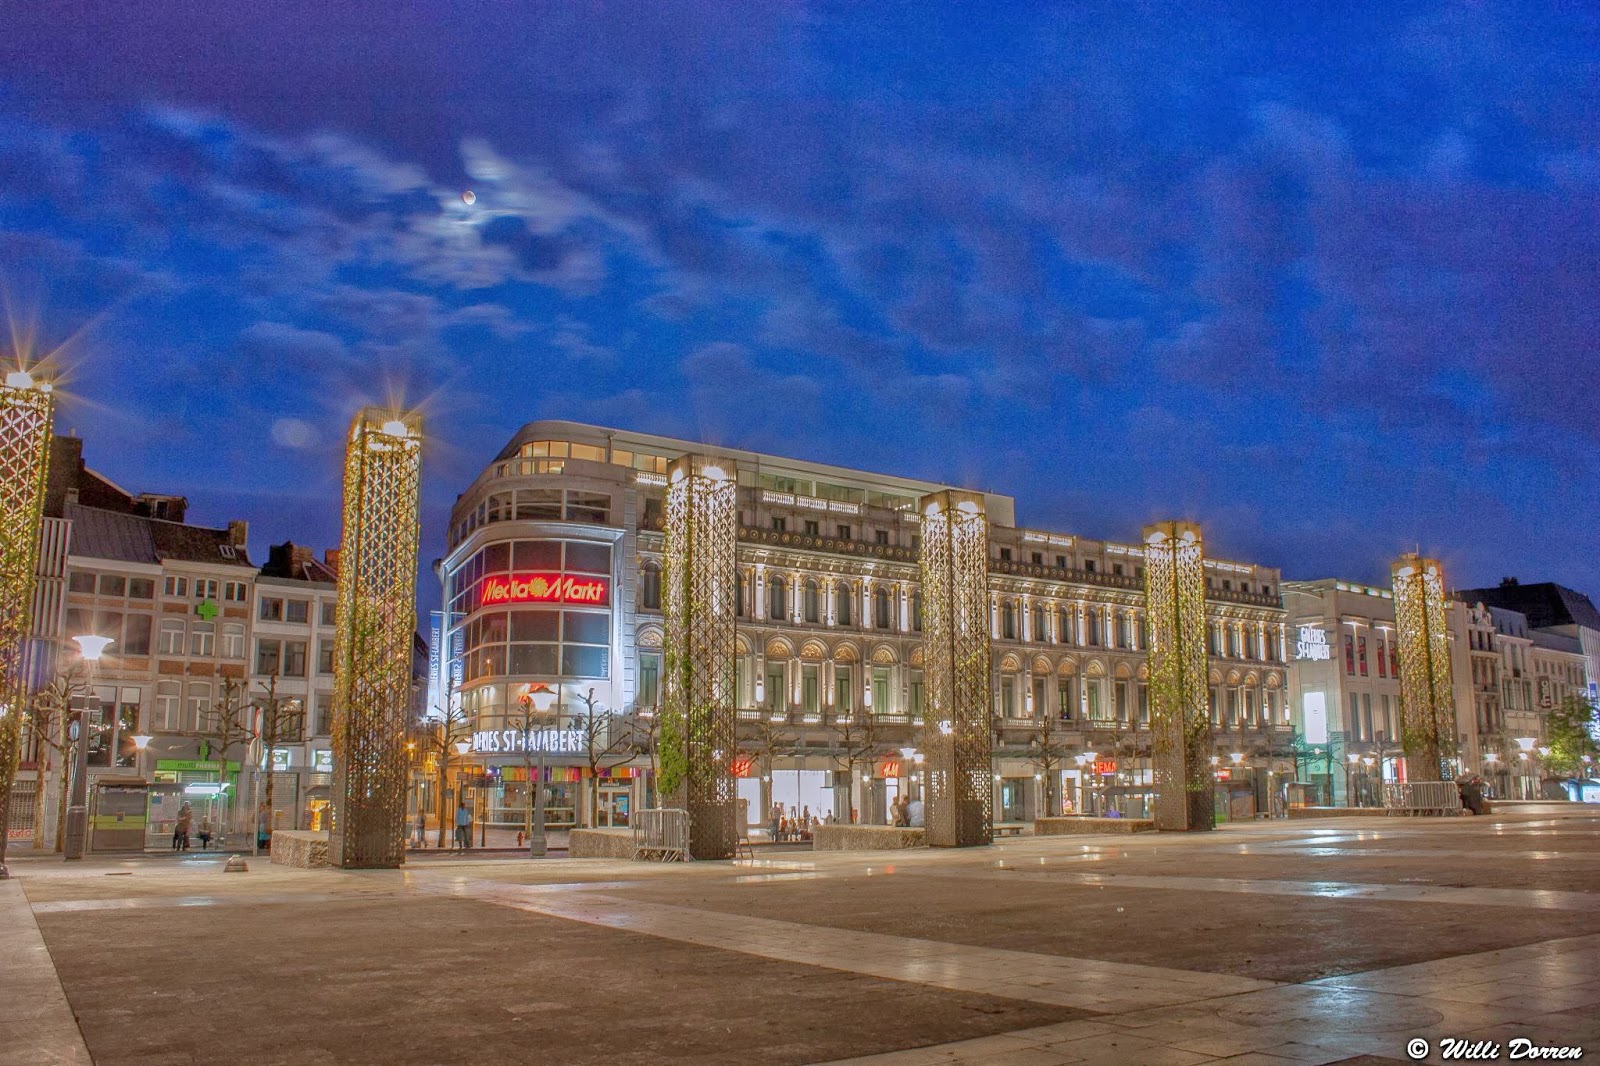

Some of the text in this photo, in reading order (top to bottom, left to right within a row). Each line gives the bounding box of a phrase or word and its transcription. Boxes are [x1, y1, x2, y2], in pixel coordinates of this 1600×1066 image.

[483, 578, 604, 601] Media Markt
[1092, 761, 1117, 774] HEMA
